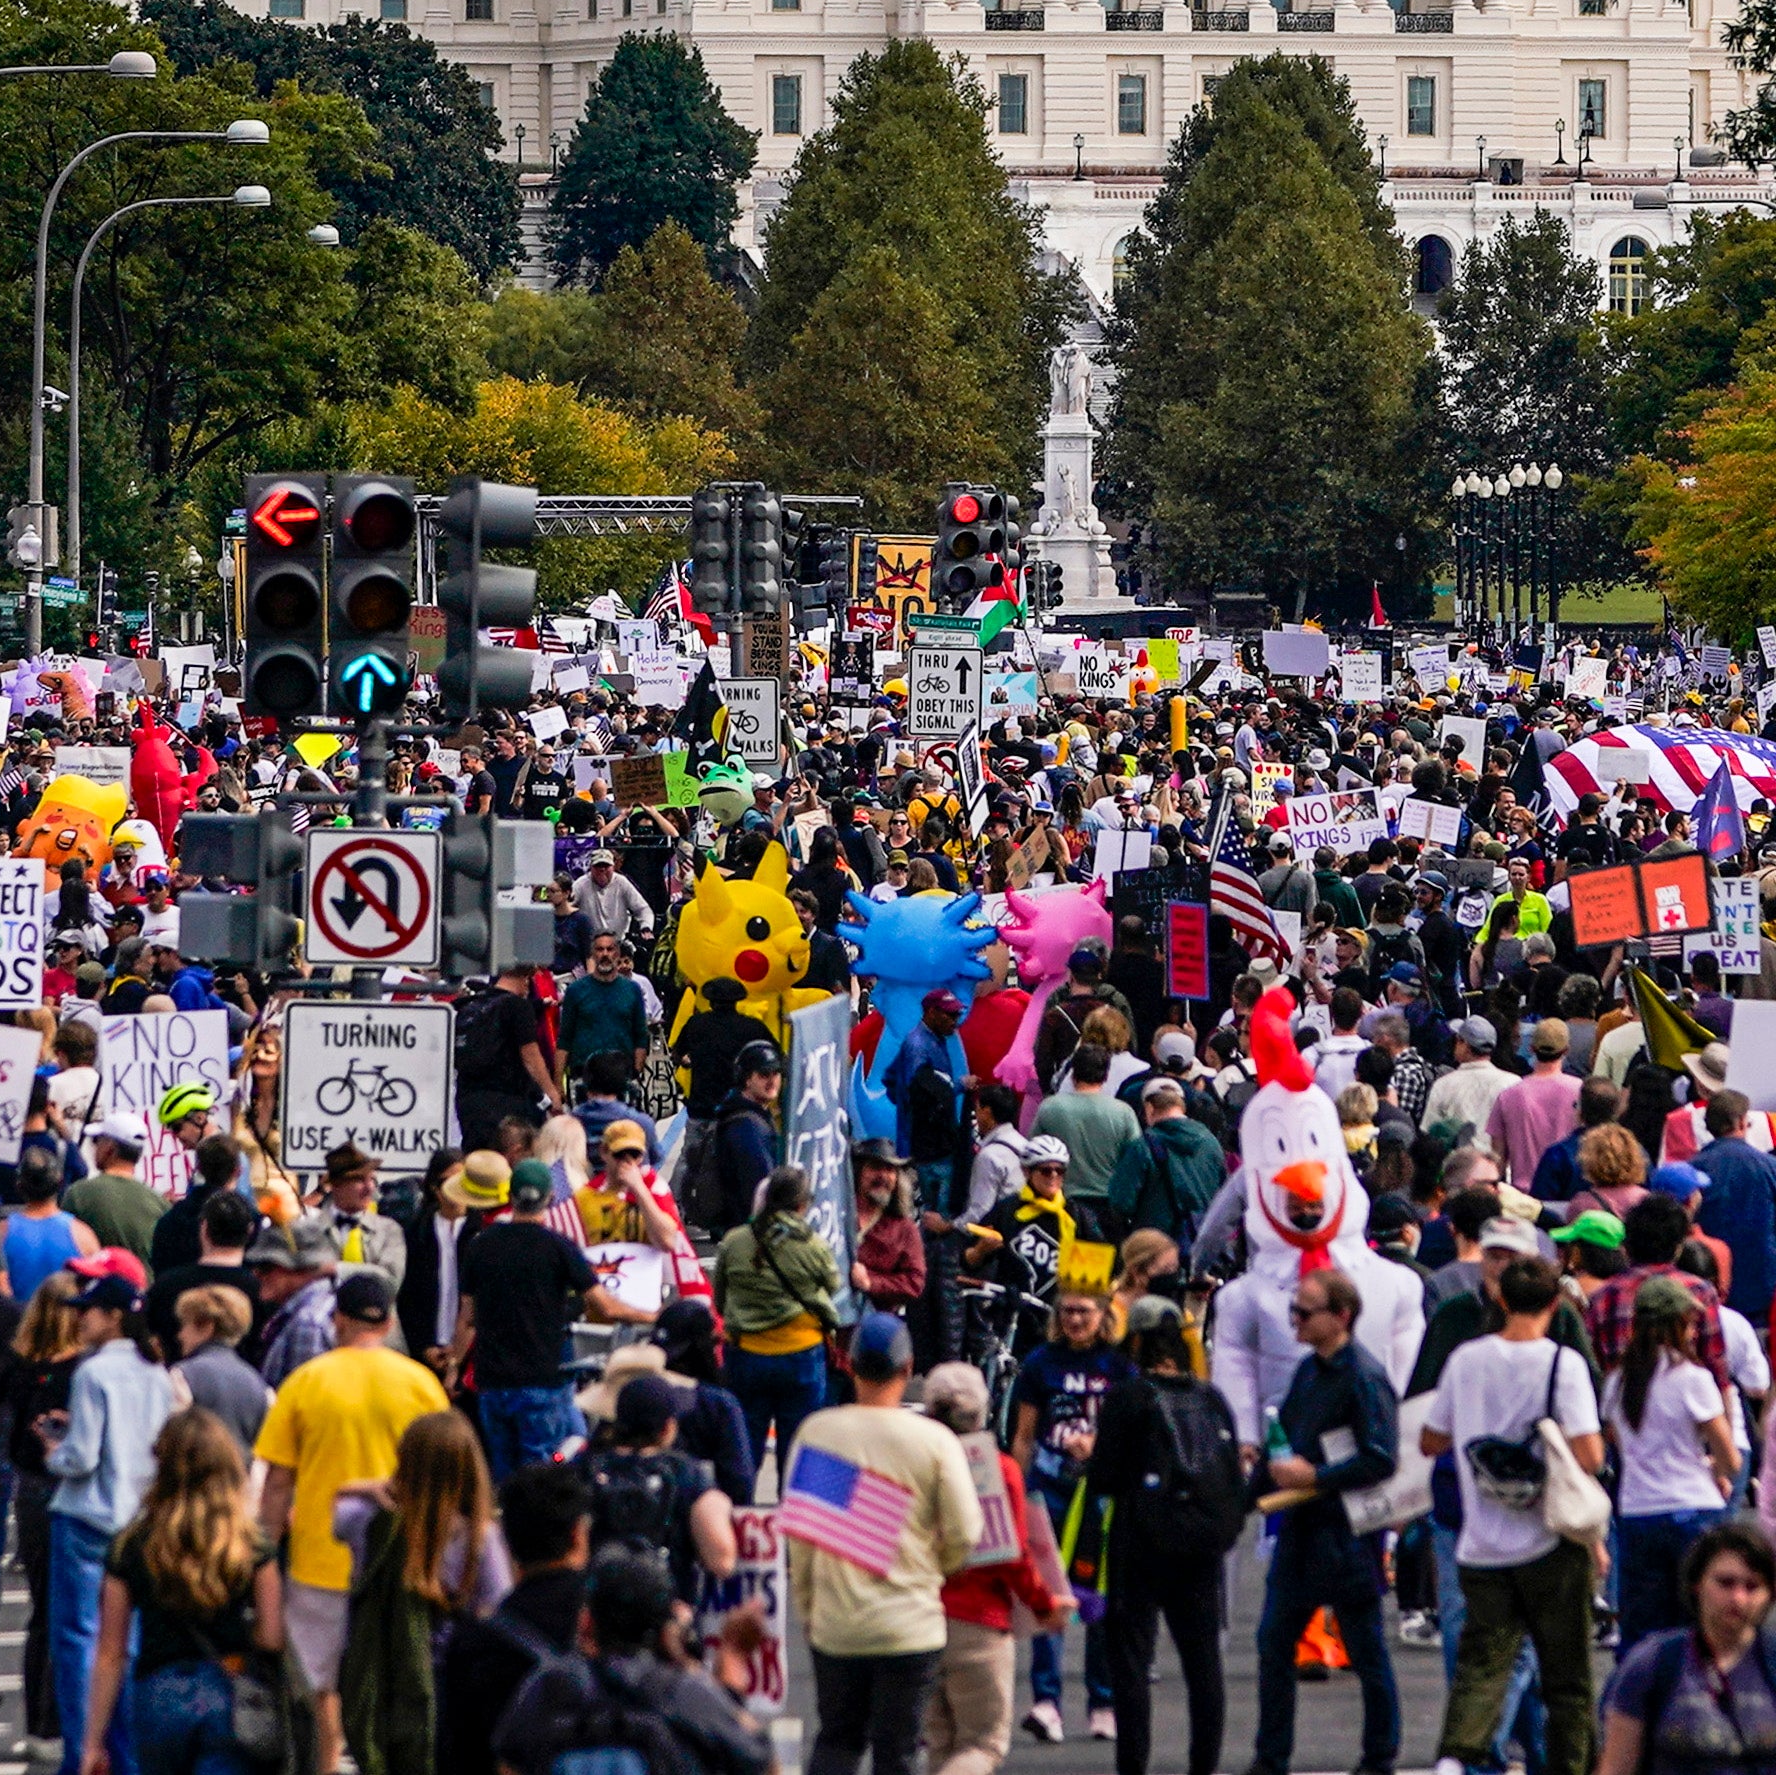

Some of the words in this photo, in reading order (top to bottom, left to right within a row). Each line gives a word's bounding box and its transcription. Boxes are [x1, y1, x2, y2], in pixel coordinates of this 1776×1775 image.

[752, 635, 782, 648] STAND
[637, 653, 658, 665] Hold
[661, 655, 673, 663] on
[750, 649, 781, 660] BEFORE
[918, 654, 949, 669] THRU
[750, 660, 781, 671] KINGS
[1079, 655, 1098, 672] NO
[636, 676, 673, 687] Democracy
[1079, 672, 1116, 689] KINGS
[916, 699, 948, 714] OBEY
[950, 699, 975, 714] THIS
[916, 715, 957, 730] SIGNAL
[1292, 801, 1329, 826] NO
[1294, 826, 1352, 850] KINGS
[1726, 921, 1754, 934] KE
[1710, 934, 1738, 948] US
[132, 1014, 197, 1064] NO
[321, 1022, 417, 1051] TURNING
[289, 1125, 332, 1152] USE
